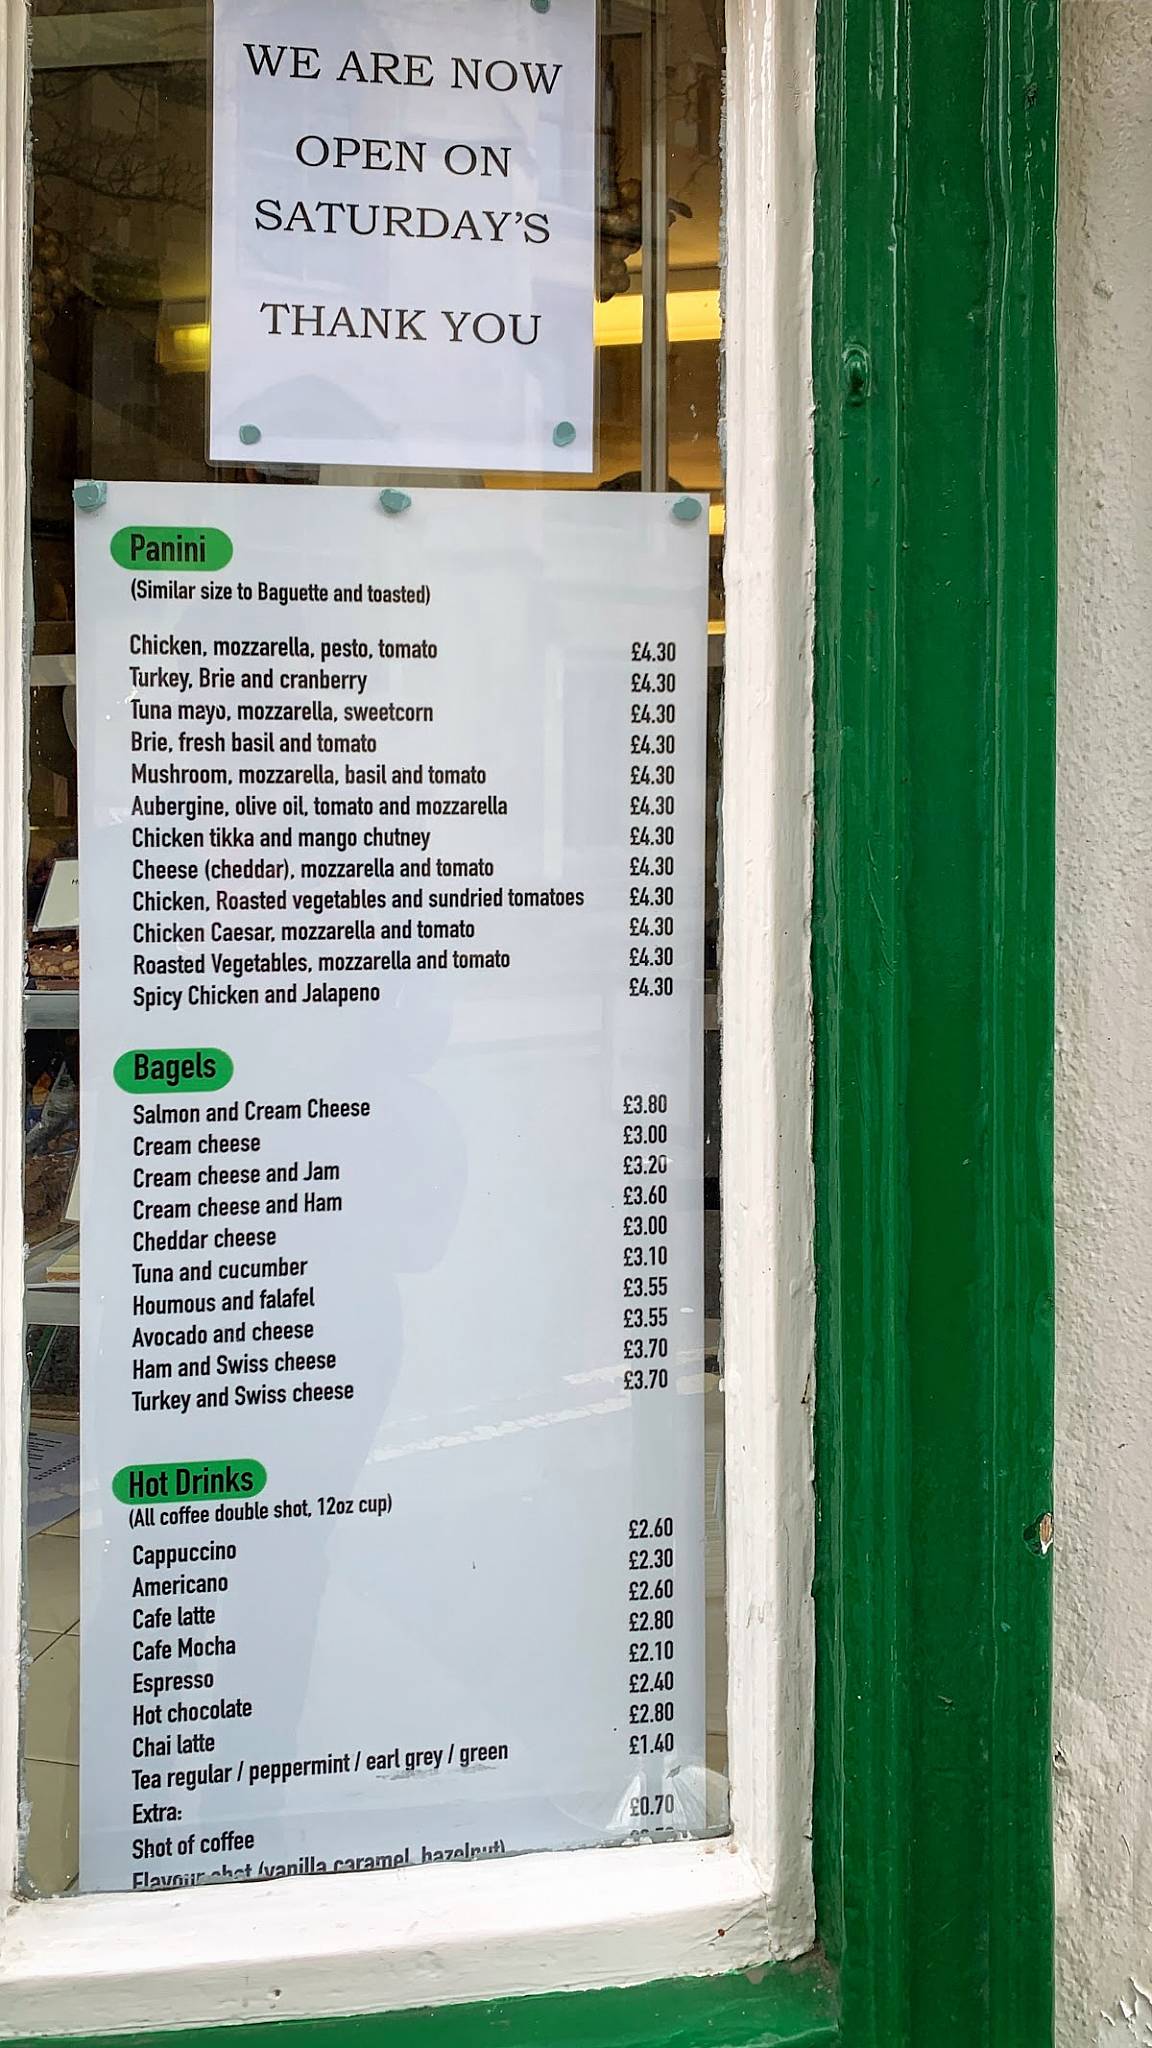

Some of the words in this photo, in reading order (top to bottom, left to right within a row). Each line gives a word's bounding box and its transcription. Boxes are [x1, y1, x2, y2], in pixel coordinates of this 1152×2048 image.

[242, 43, 321, 80] WE
[335, 50, 434, 87] ARE
[450, 57, 563, 95] NOW
[295, 135, 427, 173] OPEN
[444, 144, 512, 178] ON
[255, 199, 550, 244] SATURDAY’S
[259, 302, 427, 341] THANK
[440, 310, 542, 346] YOU
[130, 533, 206, 563] Panini
[130, 577, 196, 602] (Similar
[200, 580, 233, 600] size
[236, 582, 253, 601] to
[258, 581, 329, 607] Baguette
[333, 583, 363, 603] and
[367, 584, 431, 606] toasted)
[130, 633, 208, 657] Chicken,
[213, 635, 315, 659] mozzarella,
[320, 638, 373, 663] pesto,
[377, 638, 438, 659] tomato
[631, 641, 676, 662] £4.30
[130, 666, 193, 693] Turkey,
[199, 667, 235, 688] Brie
[241, 667, 274, 689] and
[280, 668, 368, 695] cranberry
[130, 698, 172, 720] Tuna
[178, 704, 232, 726] mayo,
[237, 700, 338, 723] mozzarella,
[343, 702, 433, 722] sweetcorn
[631, 703, 676, 724] £4.30
[131, 763, 233, 786] Mushroom,
[238, 763, 339, 786] mozzarella,
[345, 763, 387, 785] basil
[391, 764, 423, 785] and
[427, 765, 486, 785] tomato
[131, 795, 230, 821] Aubergine,
[235, 795, 277, 816] olive
[282, 795, 309, 817] oil,
[313, 796, 374, 816] tomato
[378, 795, 410, 816] and
[416, 795, 508, 816] mozzarella
[132, 827, 204, 848] Chicken
[208, 826, 255, 848] tikka
[259, 826, 292, 847] and
[298, 831, 358, 852] mango
[363, 826, 431, 852] chutney
[629, 826, 675, 846] £4.30
[132, 858, 199, 880] Cheese
[204, 858, 295, 882] (cheddar),
[301, 857, 395, 879] mozzarella
[399, 857, 431, 878] and
[435, 857, 494, 877] tomato
[132, 890, 210, 912] Chicken,
[216, 889, 287, 911] Roasted
[292, 888, 387, 915] vegetables
[391, 888, 423, 909] and
[428, 887, 503, 908] sundried
[507, 887, 585, 907] tomatoes
[133, 953, 205, 975] Roasted
[210, 951, 313, 979] Vegetables,
[318, 950, 411, 972] mozzarella
[416, 949, 448, 970] and
[452, 949, 511, 969] tomato
[133, 985, 183, 1012] Spicy
[188, 984, 259, 1006] Chicken
[264, 983, 297, 1004] and
[301, 982, 380, 1008] Jalapeno
[629, 976, 674, 997] £4.30
[134, 1051, 217, 1086] Bagels
[133, 1103, 200, 1125] Salmon
[206, 1100, 239, 1123] and
[245, 1100, 302, 1121] Cream
[307, 1098, 370, 1119] Cheese
[623, 1094, 668, 1115] £3.80
[133, 1136, 192, 1157] Cream
[198, 1133, 261, 1154] cheese
[623, 1124, 668, 1145] £3.00
[133, 1167, 191, 1189] Cream
[197, 1164, 261, 1186] cheese
[266, 1161, 298, 1183] and
[303, 1160, 340, 1181] Jam
[623, 1154, 668, 1175] £3.20
[133, 1199, 191, 1220] Cream
[197, 1196, 260, 1218] cheese
[265, 1192, 298, 1215] and
[304, 1191, 342, 1213] Ham
[623, 1184, 668, 1206] £3.60
[623, 1215, 668, 1236] £3.00
[133, 1229, 209, 1252] Cheddar
[214, 1227, 277, 1249] cheese
[623, 1245, 668, 1267] £3.10
[131, 1263, 174, 1284] Tuna
[179, 1259, 212, 1282] and
[218, 1256, 309, 1280] cucumber
[623, 1276, 668, 1298] £3.55
[133, 1295, 216, 1316] Houmous
[221, 1289, 254, 1312] and
[259, 1286, 315, 1310] falafel
[623, 1306, 668, 1329] £3.55
[131, 1324, 208, 1348] Avocado
[213, 1321, 246, 1344] and
[252, 1320, 314, 1342] cheese
[623, 1337, 668, 1359] £3.70
[133, 1358, 172, 1380] Ham
[177, 1355, 211, 1378] and
[216, 1353, 269, 1375] Swiss
[274, 1350, 336, 1372] cheese
[623, 1368, 668, 1390] £3.70
[131, 1389, 192, 1415] Turkey
[196, 1385, 229, 1409] and
[234, 1383, 287, 1406] Swiss
[292, 1381, 354, 1403] cheese
[129, 1470, 169, 1499] Hot
[176, 1465, 254, 1496] Drinks
[128, 1507, 156, 1530] (All
[159, 1505, 210, 1526] coffee
[215, 1501, 269, 1523] double
[273, 1499, 312, 1519] shot,
[317, 1496, 354, 1516] 12oz
[358, 1493, 392, 1517] cup)
[628, 1517, 674, 1540] £2.60
[133, 1540, 237, 1569] Cappuccino
[628, 1547, 674, 1571] £2.30
[131, 1573, 228, 1598] Americano
[628, 1578, 674, 1601] £2.60
[132, 1607, 172, 1630] Cafe
[177, 1605, 216, 1627] latte
[628, 1609, 674, 1632] £2.80
[132, 1639, 172, 1662] Cafe
[177, 1635, 236, 1659] Mocha
[628, 1640, 674, 1663] £2.10
[132, 1672, 214, 1698] Espresso
[629, 1670, 674, 1694] £2.40
[133, 1704, 163, 1726] Hot
[167, 1698, 253, 1723] chocolate
[629, 1701, 674, 1725] £2.80
[132, 1734, 172, 1758] Chai
[176, 1733, 215, 1755] latte
[629, 1732, 674, 1755] £1.40
[131, 1769, 162, 1791] Tea
[167, 1763, 233, 1792] regular
[249, 1753, 351, 1786] peppermint
[366, 1748, 401, 1771] earl
[405, 1749, 444, 1772] grey
[459, 1744, 508, 1768] green
[132, 1803, 182, 1825] Extra:
[630, 1794, 675, 1817] £0.70
[131, 1837, 173, 1860] Shot
[177, 1833, 196, 1856] of
[200, 1830, 255, 1854] coffee
